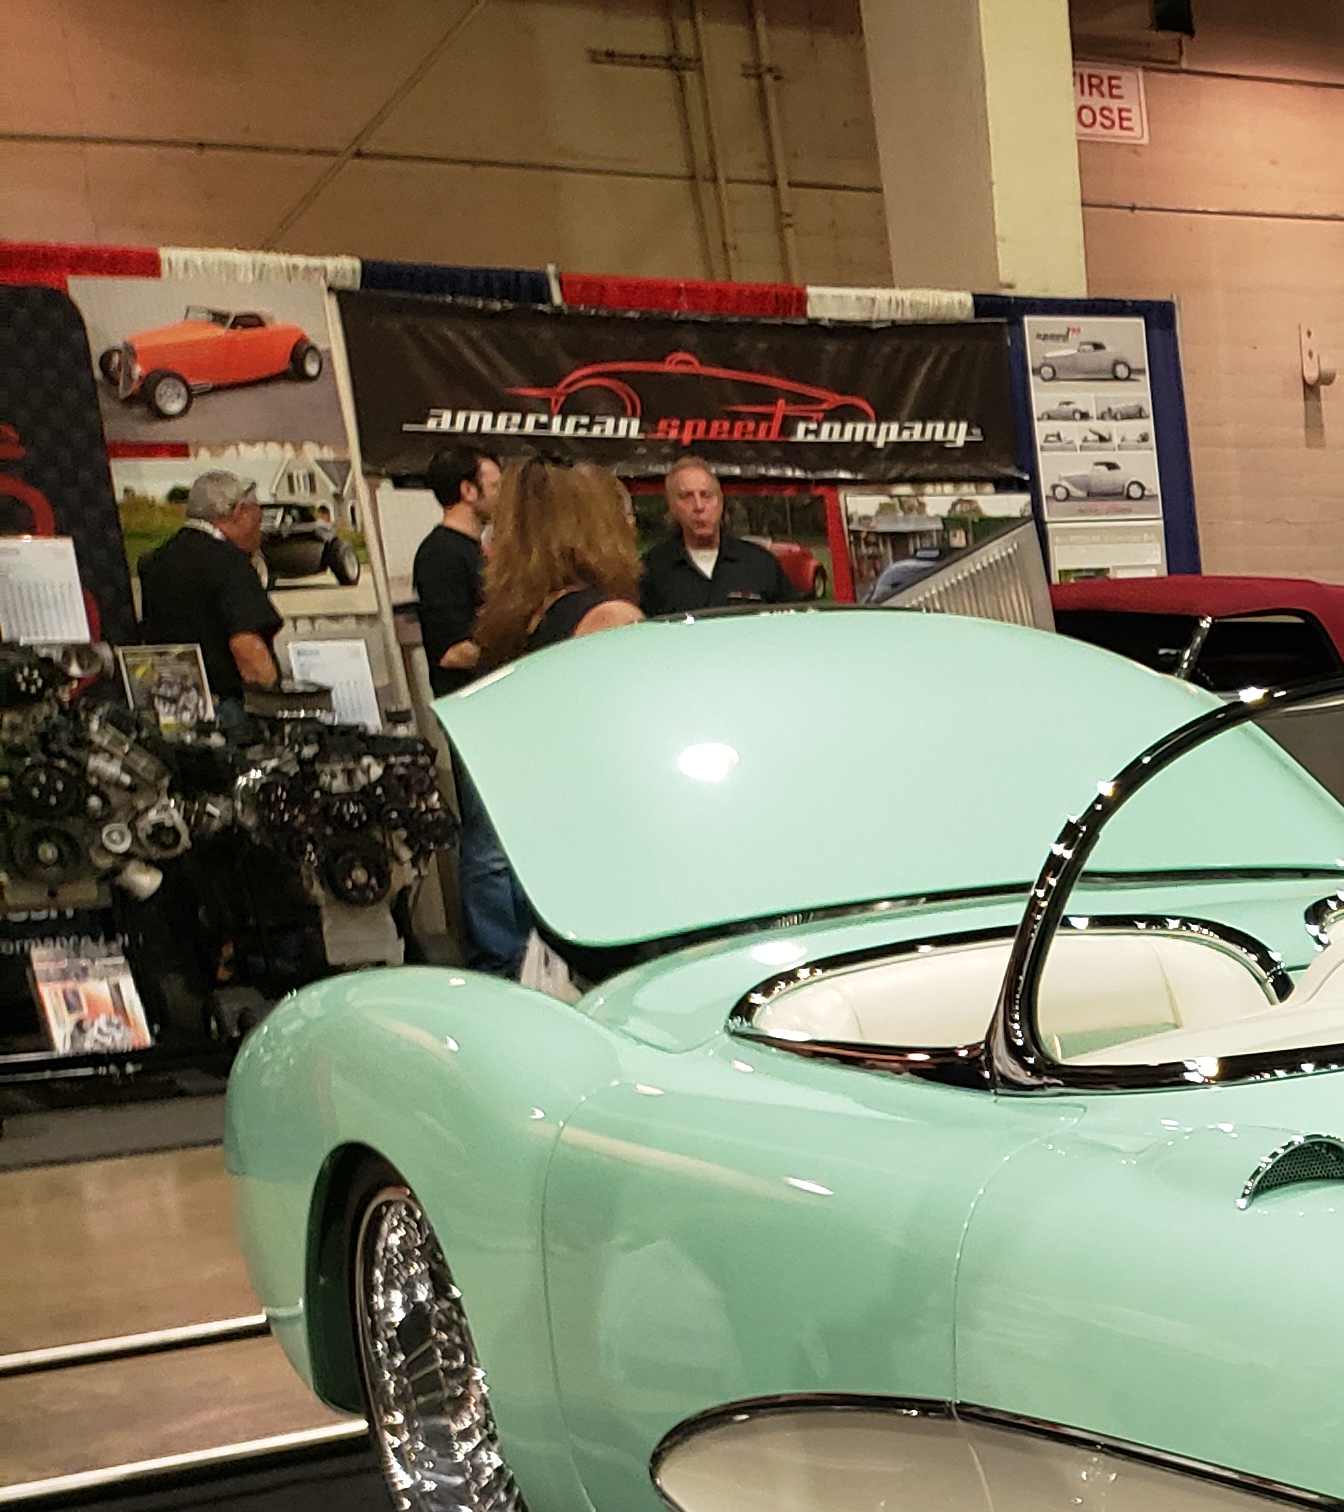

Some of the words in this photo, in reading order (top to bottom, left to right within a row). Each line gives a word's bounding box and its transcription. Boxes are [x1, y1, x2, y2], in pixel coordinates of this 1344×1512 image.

[1074, 71, 1125, 99] IRE
[1077, 104, 1135, 132] OSE
[424, 407, 643, 440] american
[655, 398, 787, 446] speed
[795, 419, 969, 449] company
